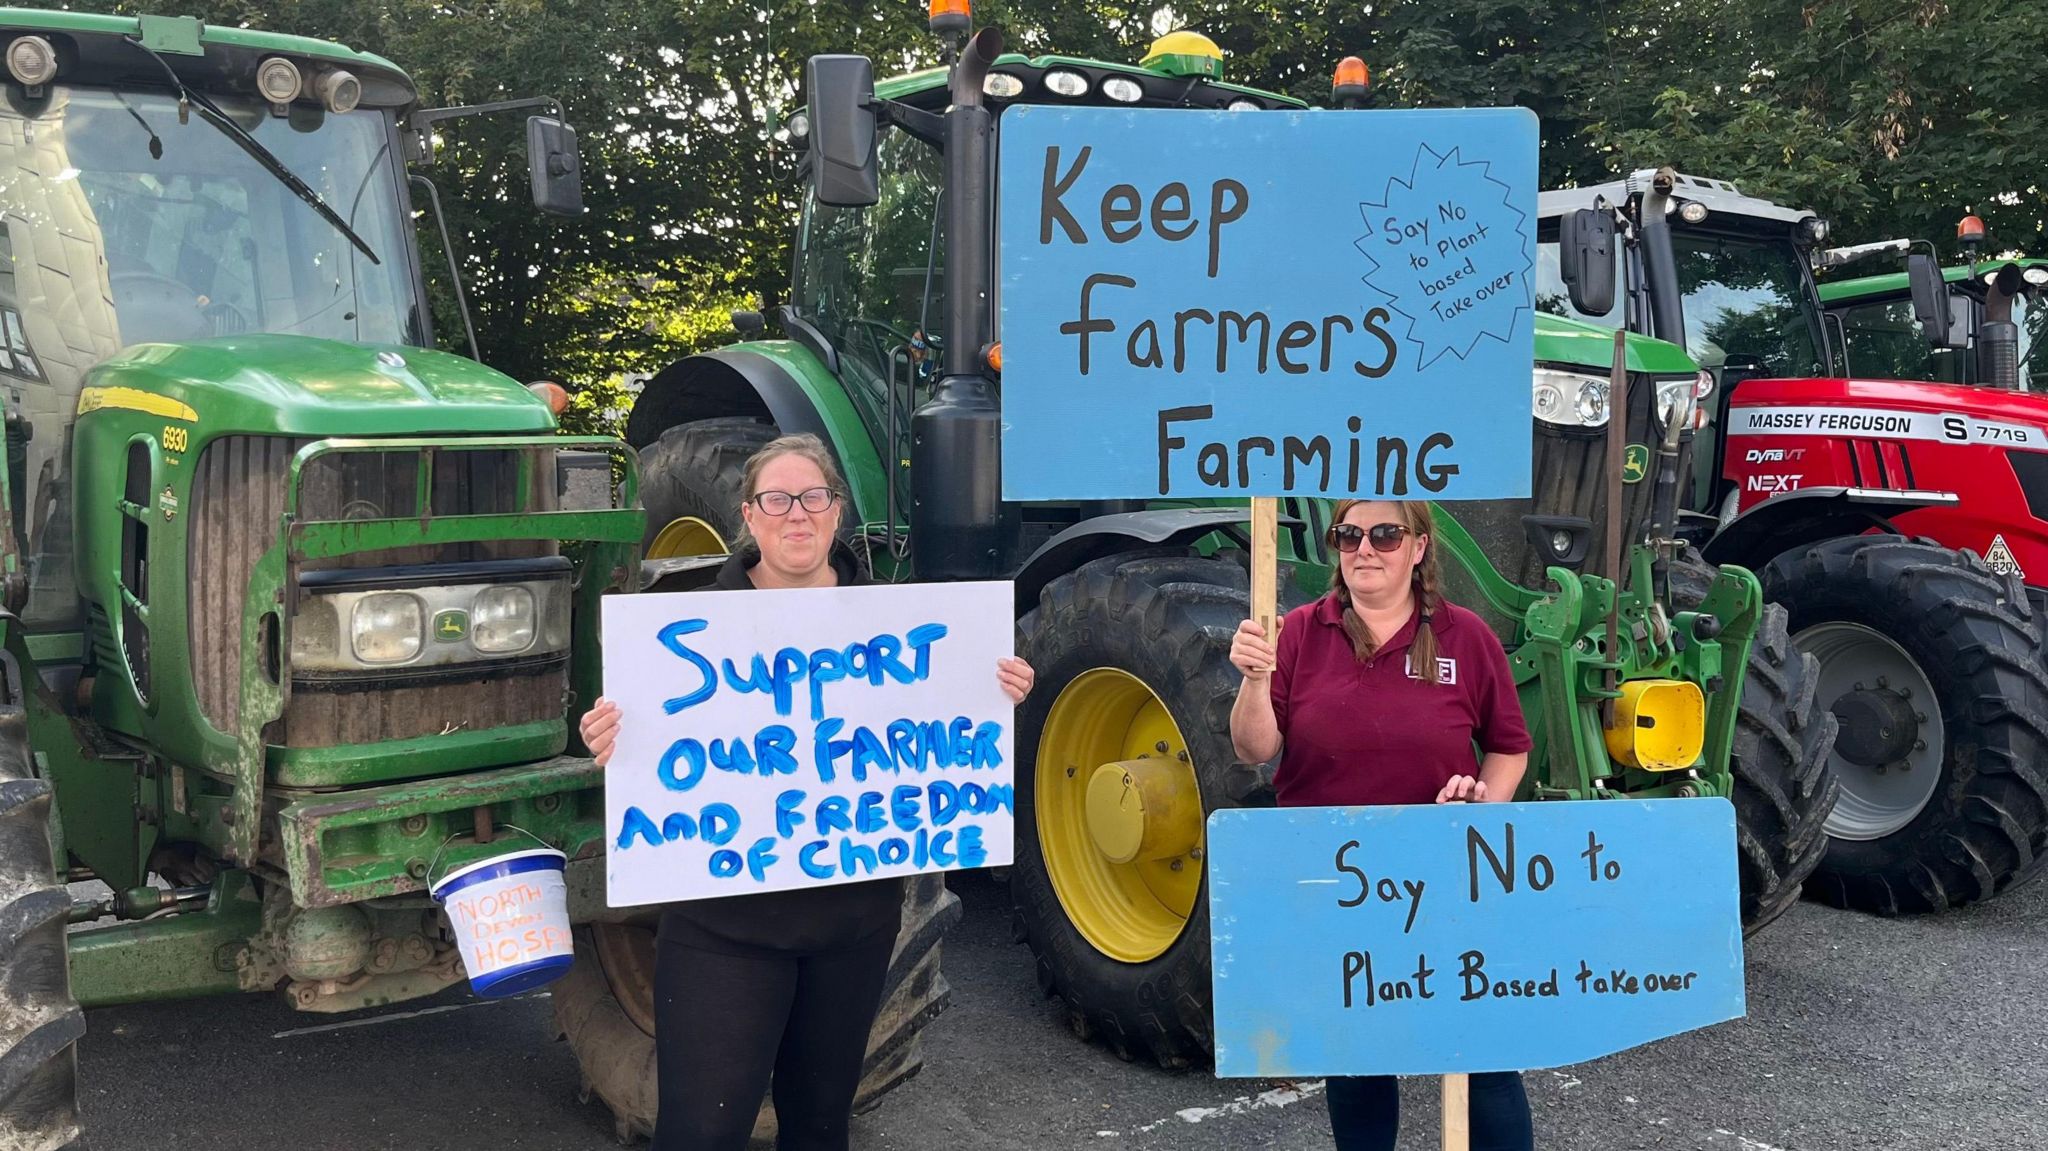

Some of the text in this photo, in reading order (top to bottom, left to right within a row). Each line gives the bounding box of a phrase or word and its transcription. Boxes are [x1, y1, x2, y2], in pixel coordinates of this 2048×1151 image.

[1040, 146, 1249, 277] Keep
[1384, 201, 1466, 246] Say No
[1410, 222, 1489, 271] to Plant
[1419, 257, 1476, 296] based
[163, 426, 188, 452] 6930
[1749, 414, 1912, 433] MASSEY FERGUSON
[1943, 417, 2028, 442] S 7719
[1747, 474, 1804, 491] NEXT
[1993, 551, 2005, 561] 84
[814, 716, 1004, 783] FARMER
[776, 780, 1013, 839] FREEDOM
[709, 837, 778, 882] OF
[1336, 823, 1620, 933] Say No to
[457, 884, 542, 925] NORTH
[1343, 951, 1434, 1008] Plant
[1459, 950, 1559, 1001] Based
